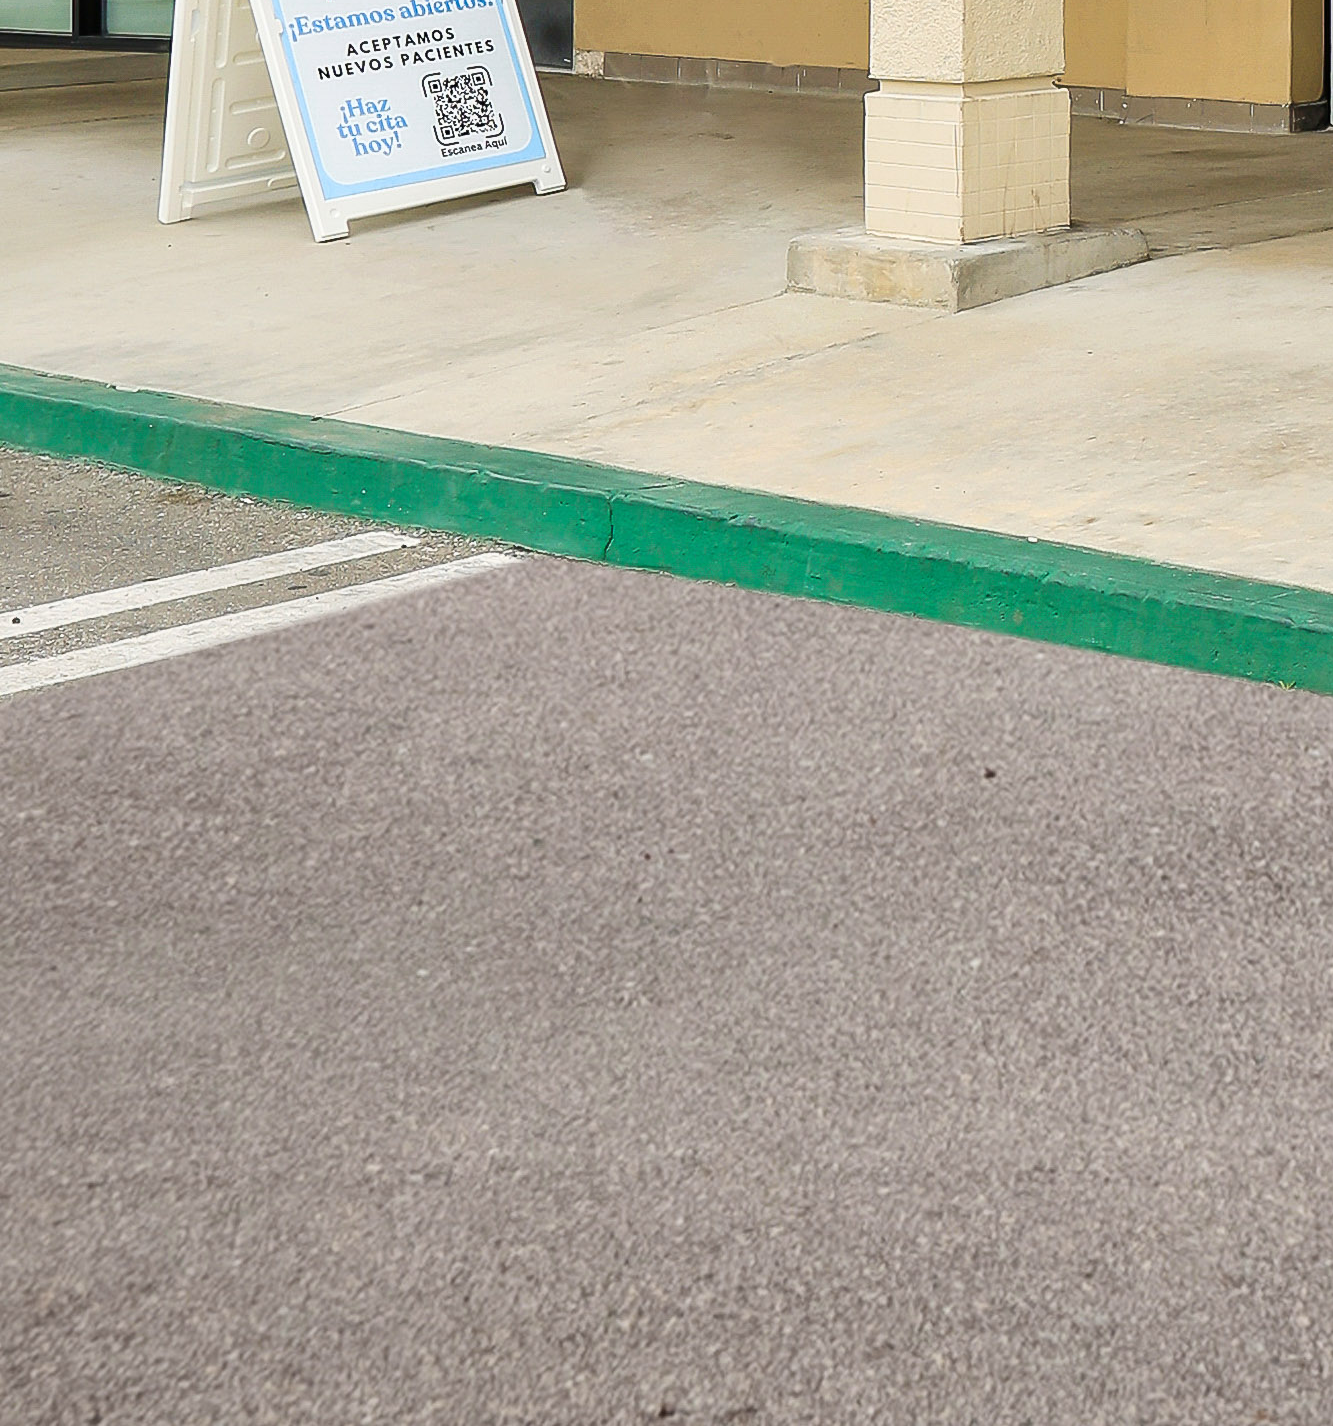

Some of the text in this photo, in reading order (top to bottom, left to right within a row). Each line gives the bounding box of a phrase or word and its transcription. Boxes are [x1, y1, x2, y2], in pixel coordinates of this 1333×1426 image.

[288, 10, 395, 42] ¡Estamos
[347, 27, 455, 56] ACEPTAMOS
[317, 40, 494, 80] NUEVOS PACIENTES
[340, 98, 391, 124] ¡Haz
[337, 114, 408, 138] tu cita
[352, 131, 402, 156] hoy!
[441, 136, 507, 157] Escanea Aquí
